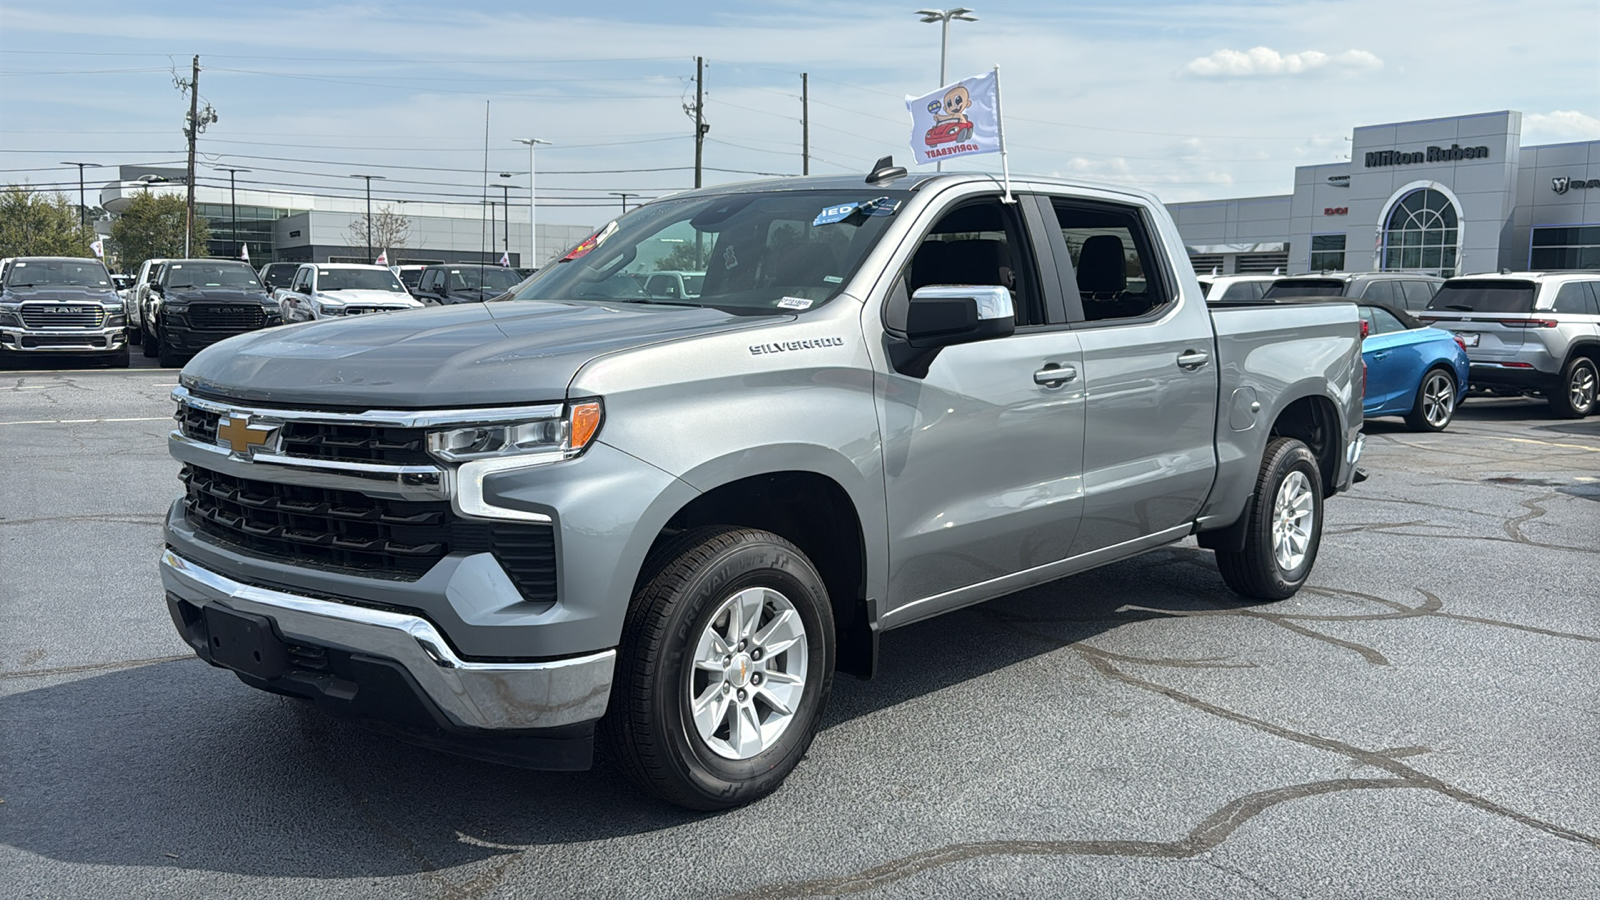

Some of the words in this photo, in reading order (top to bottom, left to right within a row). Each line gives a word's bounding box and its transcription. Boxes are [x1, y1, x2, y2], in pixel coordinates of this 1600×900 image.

[1365, 150, 1424, 168] Milton
[1426, 144, 1489, 162] Ruben
[749, 337, 844, 356] SILVERADO
[678, 565, 735, 640] PREVAIL
